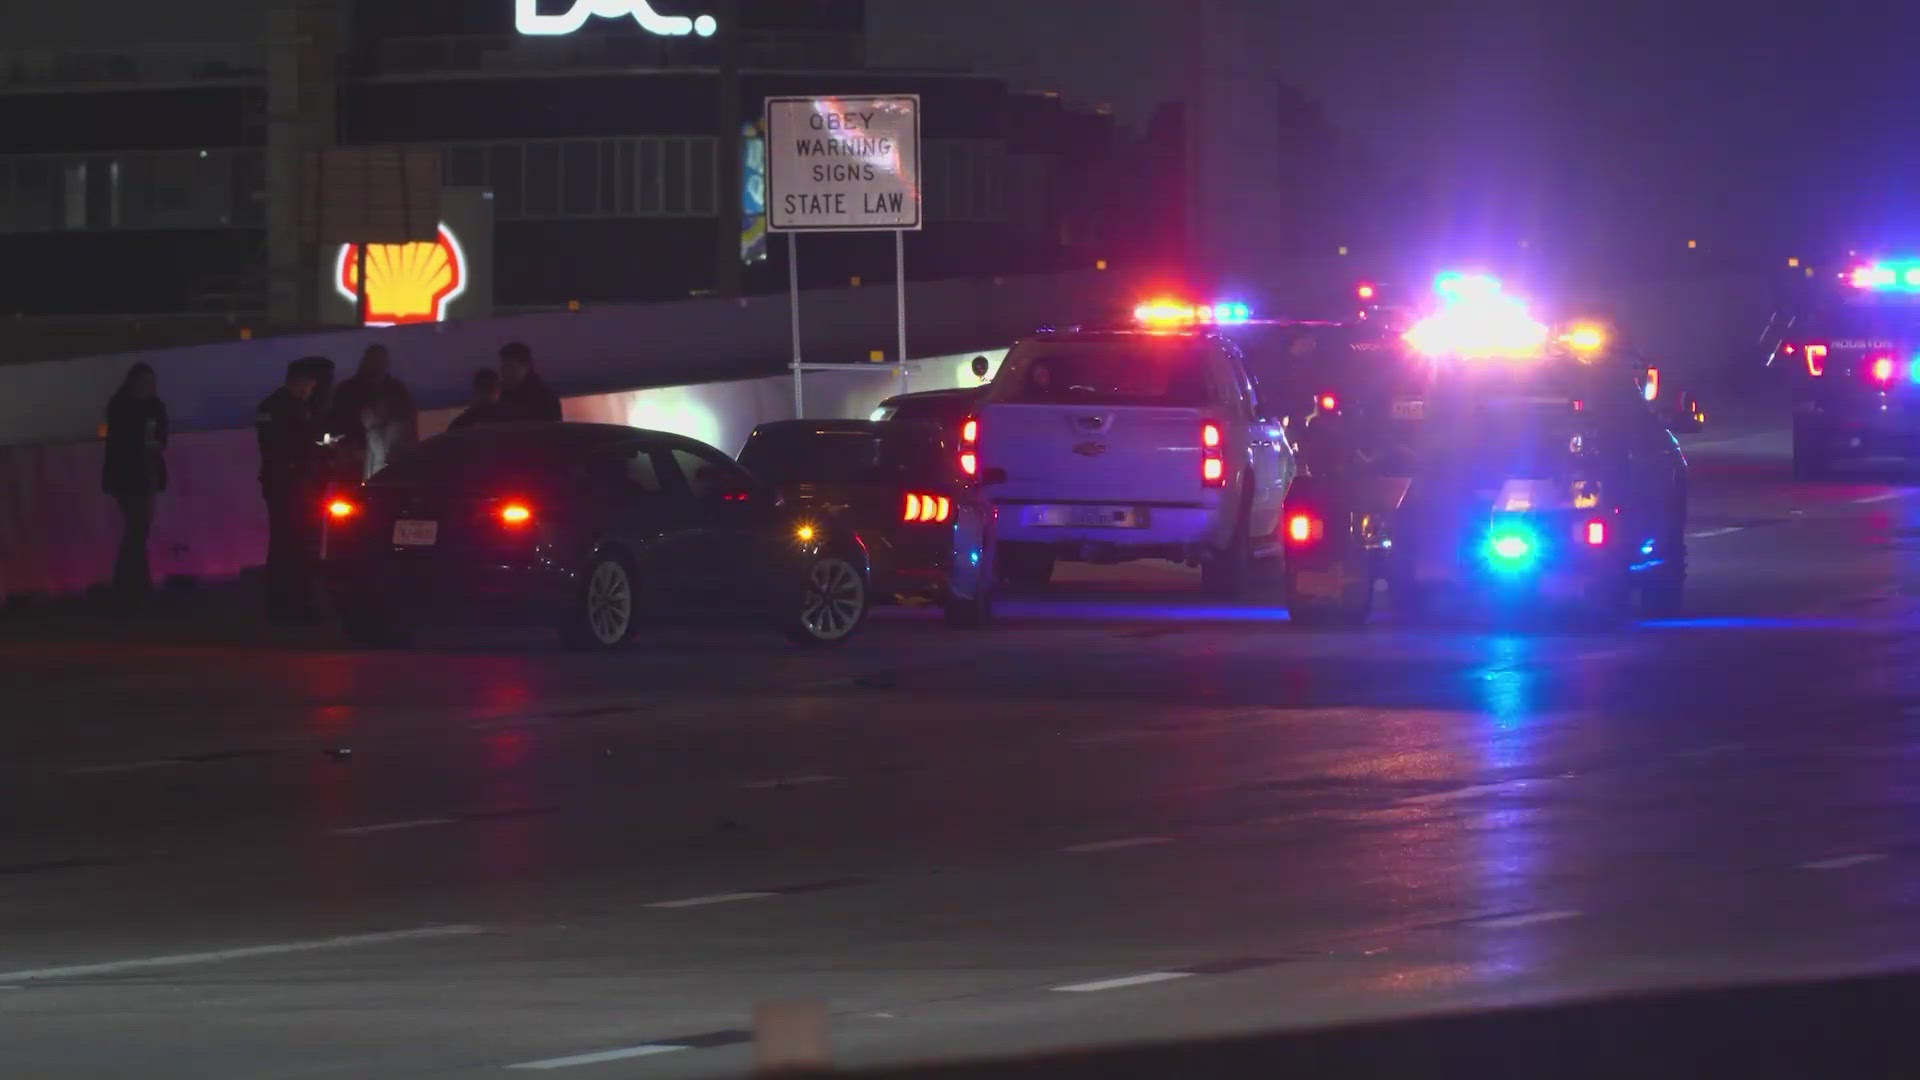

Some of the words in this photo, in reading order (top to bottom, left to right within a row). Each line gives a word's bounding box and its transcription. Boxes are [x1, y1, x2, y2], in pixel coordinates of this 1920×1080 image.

[810, 112, 874, 130] OBEY
[796, 137, 891, 157] WARNING
[813, 164, 874, 182] SIGNS
[784, 193, 846, 215] STATE
[864, 192, 903, 214] LAW
